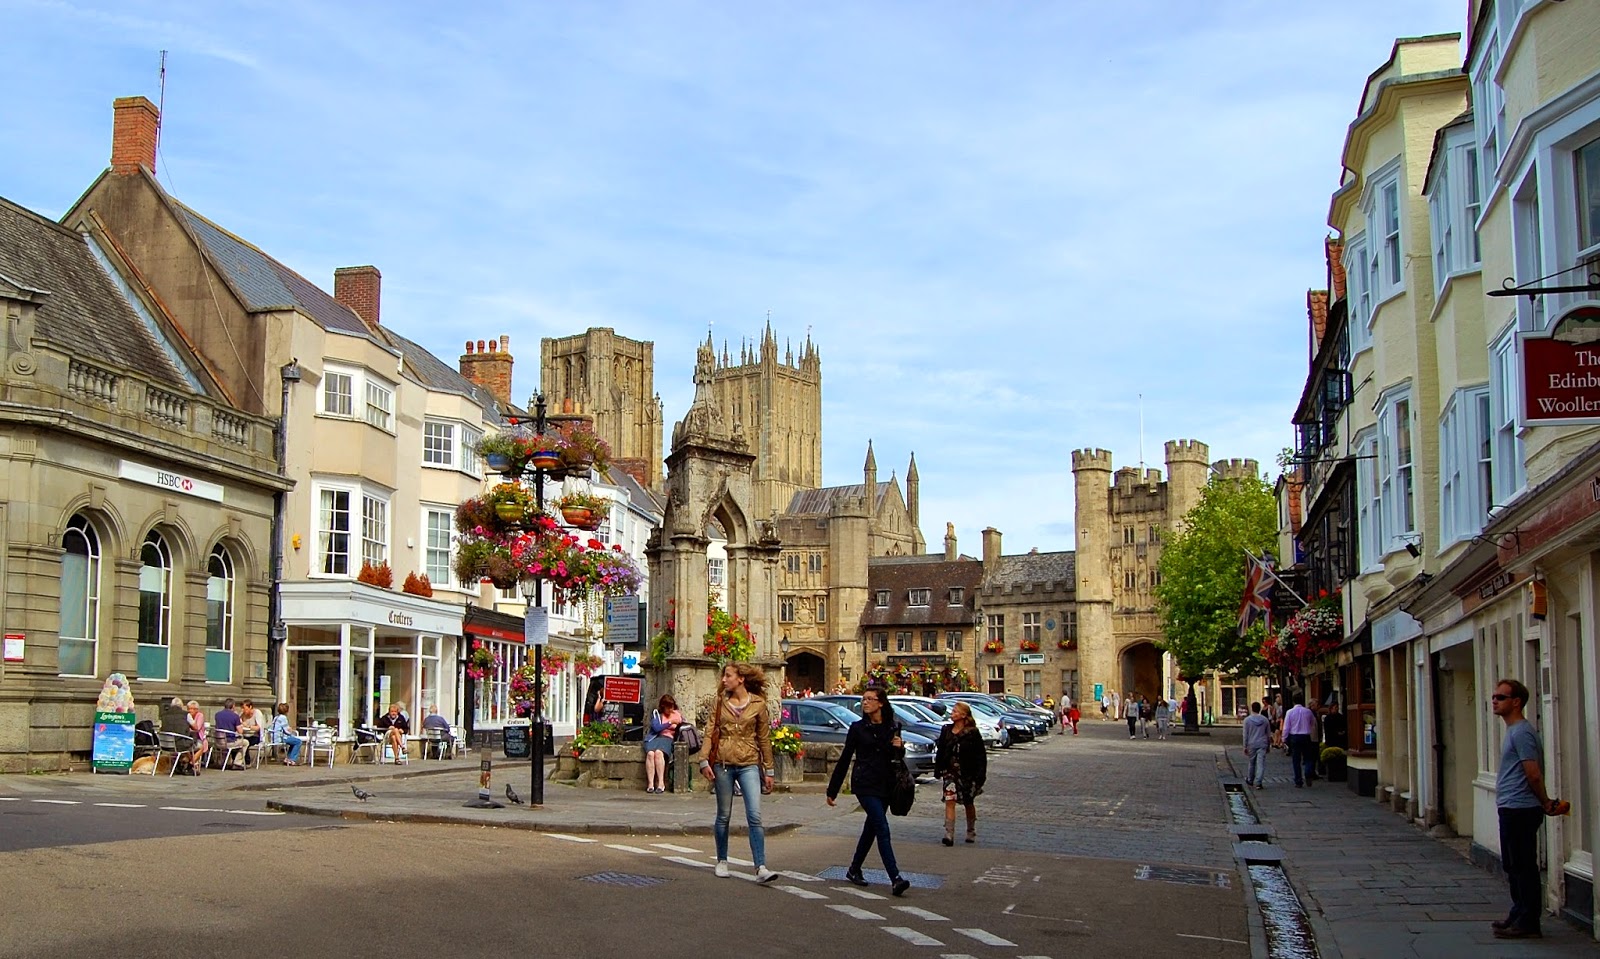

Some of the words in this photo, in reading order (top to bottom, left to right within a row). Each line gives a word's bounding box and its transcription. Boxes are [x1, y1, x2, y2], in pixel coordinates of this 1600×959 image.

[1537, 395, 1600, 413] Woollen
[157, 471, 181, 489] HSBC
[388, 610, 413, 626] Crofters
